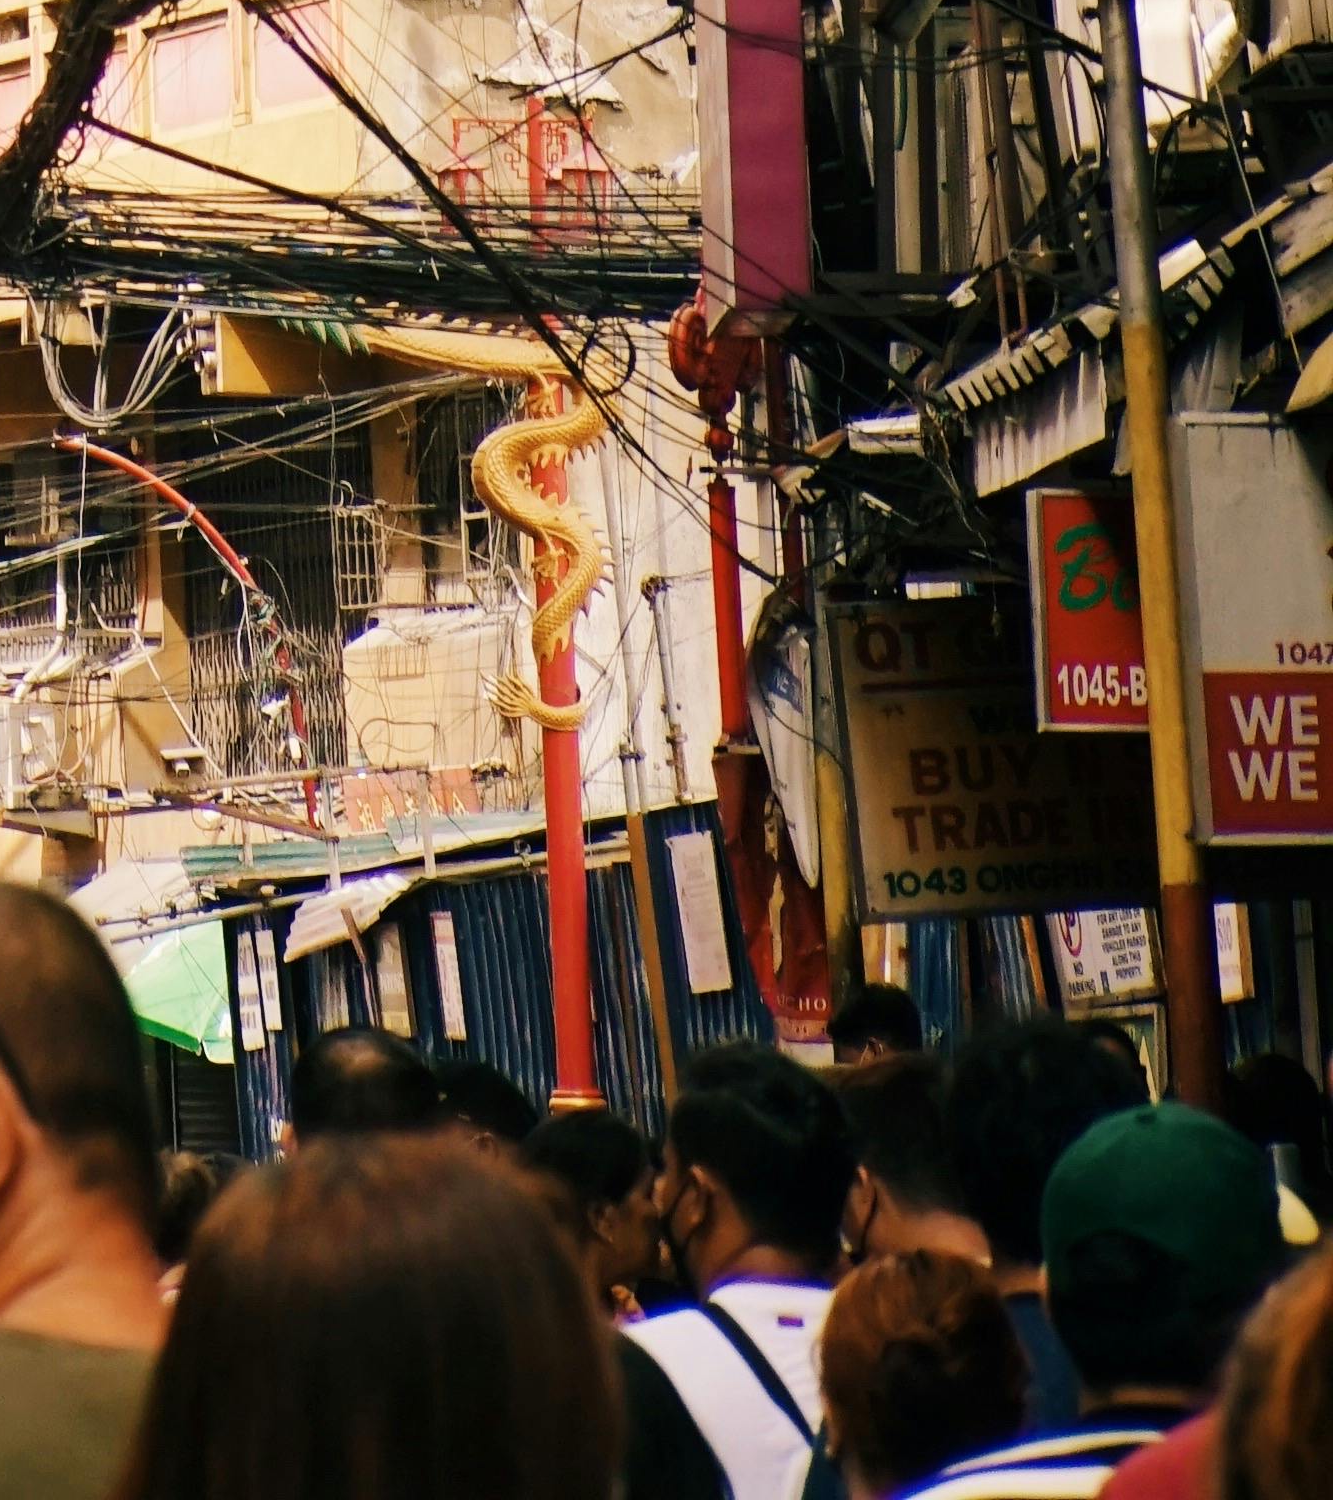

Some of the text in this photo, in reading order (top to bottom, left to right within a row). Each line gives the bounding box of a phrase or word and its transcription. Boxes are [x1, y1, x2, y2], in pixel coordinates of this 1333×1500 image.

[856, 621, 937, 672] QT
[1057, 662, 1149, 707] 1045-B
[1229, 694, 1321, 747] WE
[908, 745, 1037, 797] BUY
[1228, 749, 1319, 802] WE
[892, 798, 1073, 856] TRADE
[883, 866, 969, 900] 1043
